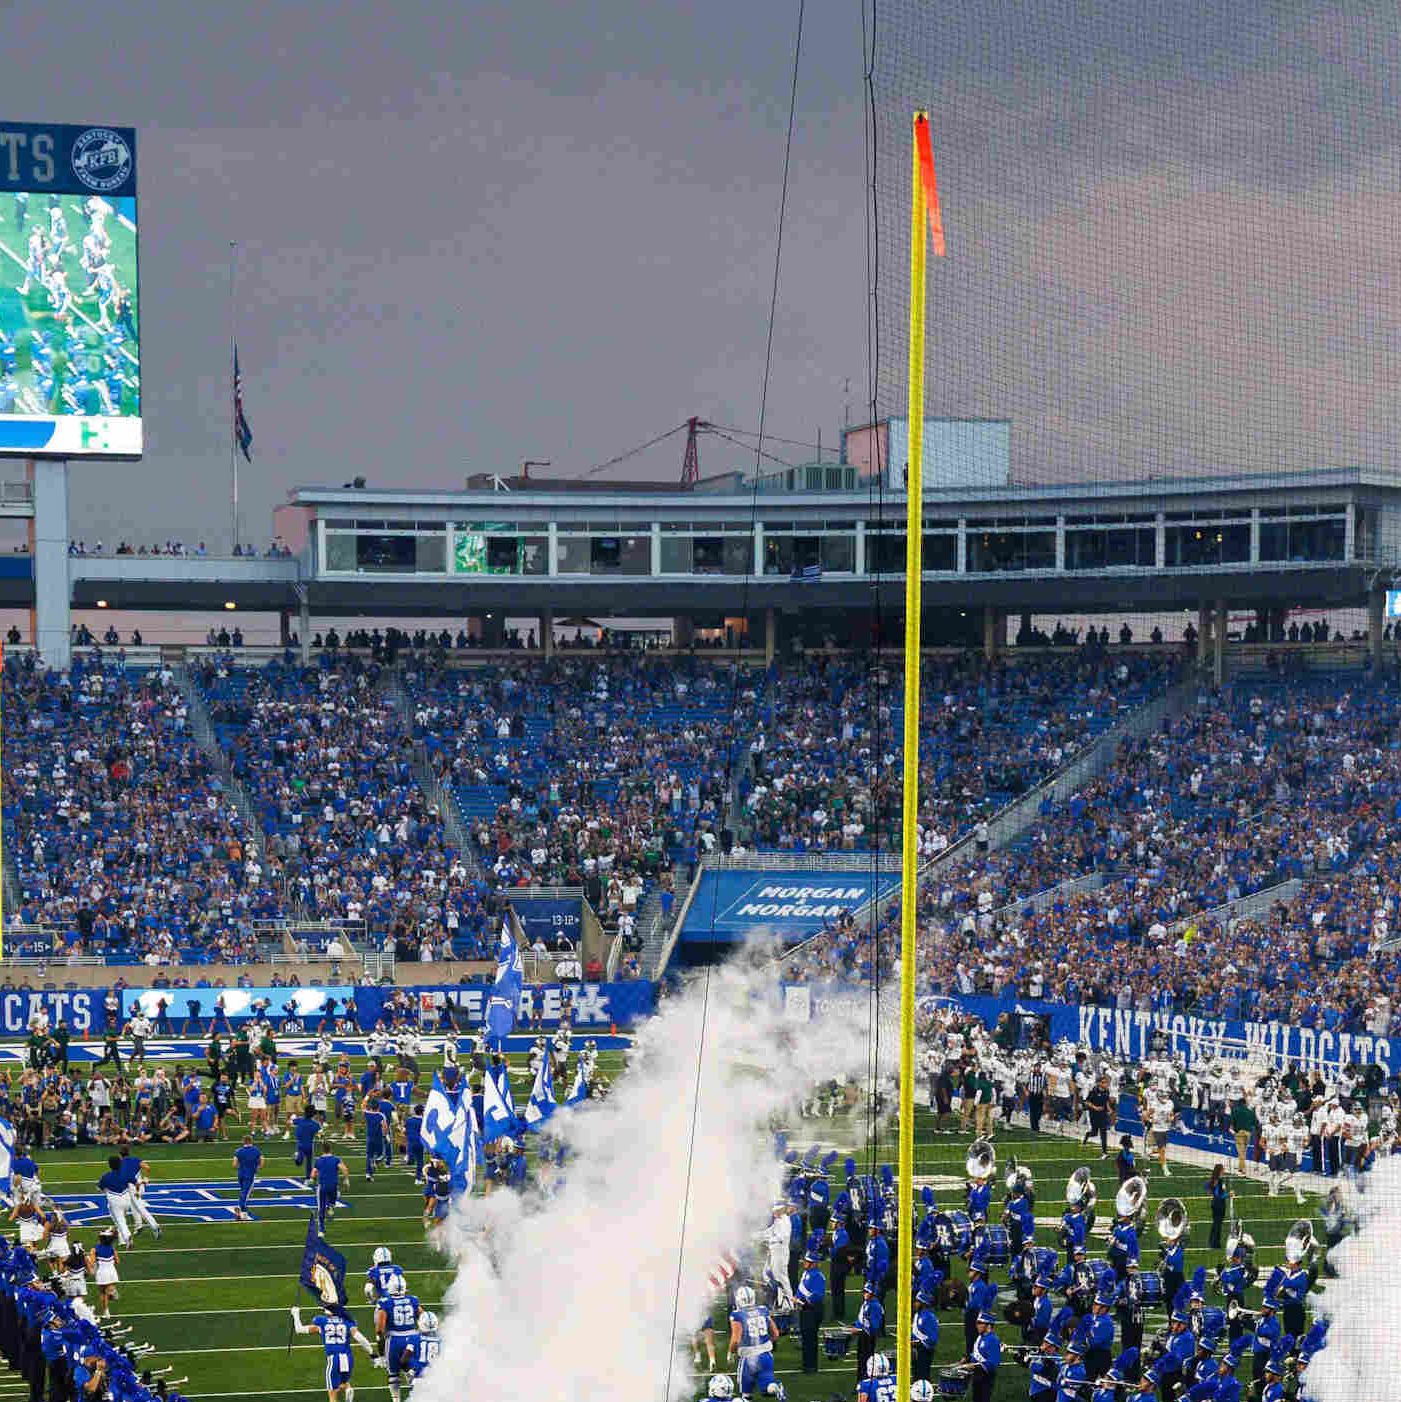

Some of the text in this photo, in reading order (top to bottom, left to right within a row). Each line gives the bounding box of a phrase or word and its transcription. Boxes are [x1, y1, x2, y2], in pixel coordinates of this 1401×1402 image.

[757, 886, 867, 899] MORGAN
[394, 1304, 415, 1326] 62
[324, 1323, 348, 1345] 29
